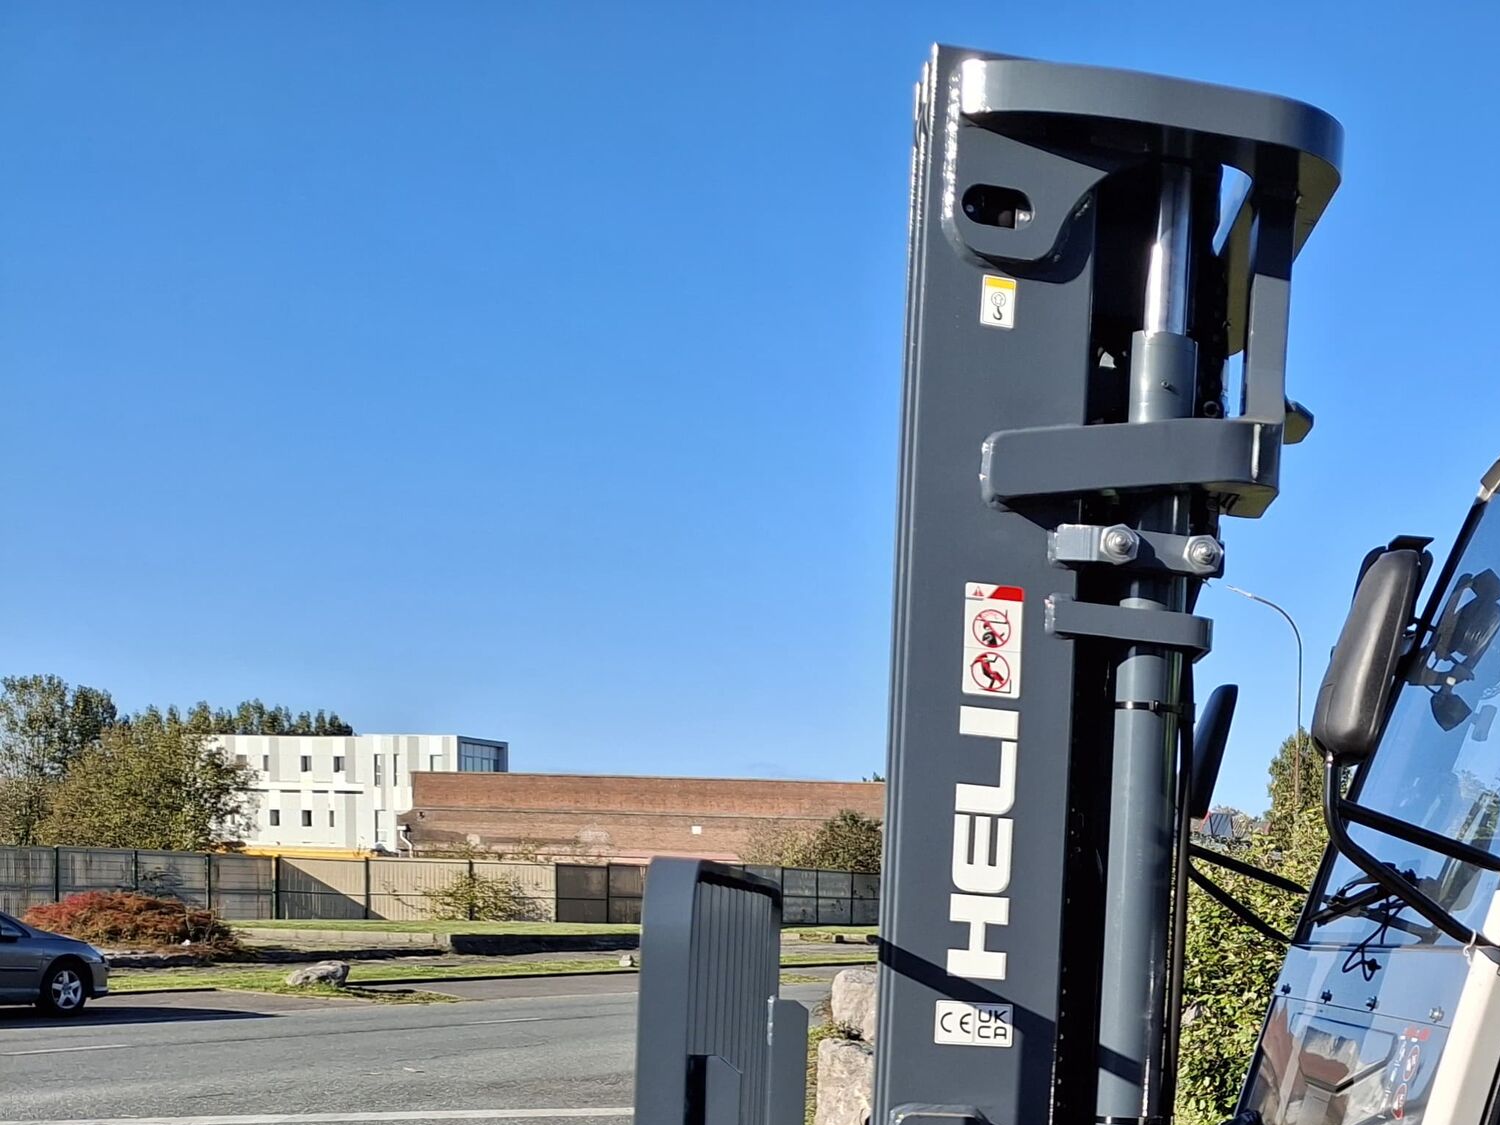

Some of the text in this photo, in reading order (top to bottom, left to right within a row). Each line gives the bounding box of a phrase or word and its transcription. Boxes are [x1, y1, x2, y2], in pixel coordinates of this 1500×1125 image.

[946, 705, 1020, 981] HELI
[940, 1011, 972, 1035] CE
[978, 1009, 1008, 1025] UK
[977, 1026, 1008, 1040] CA
